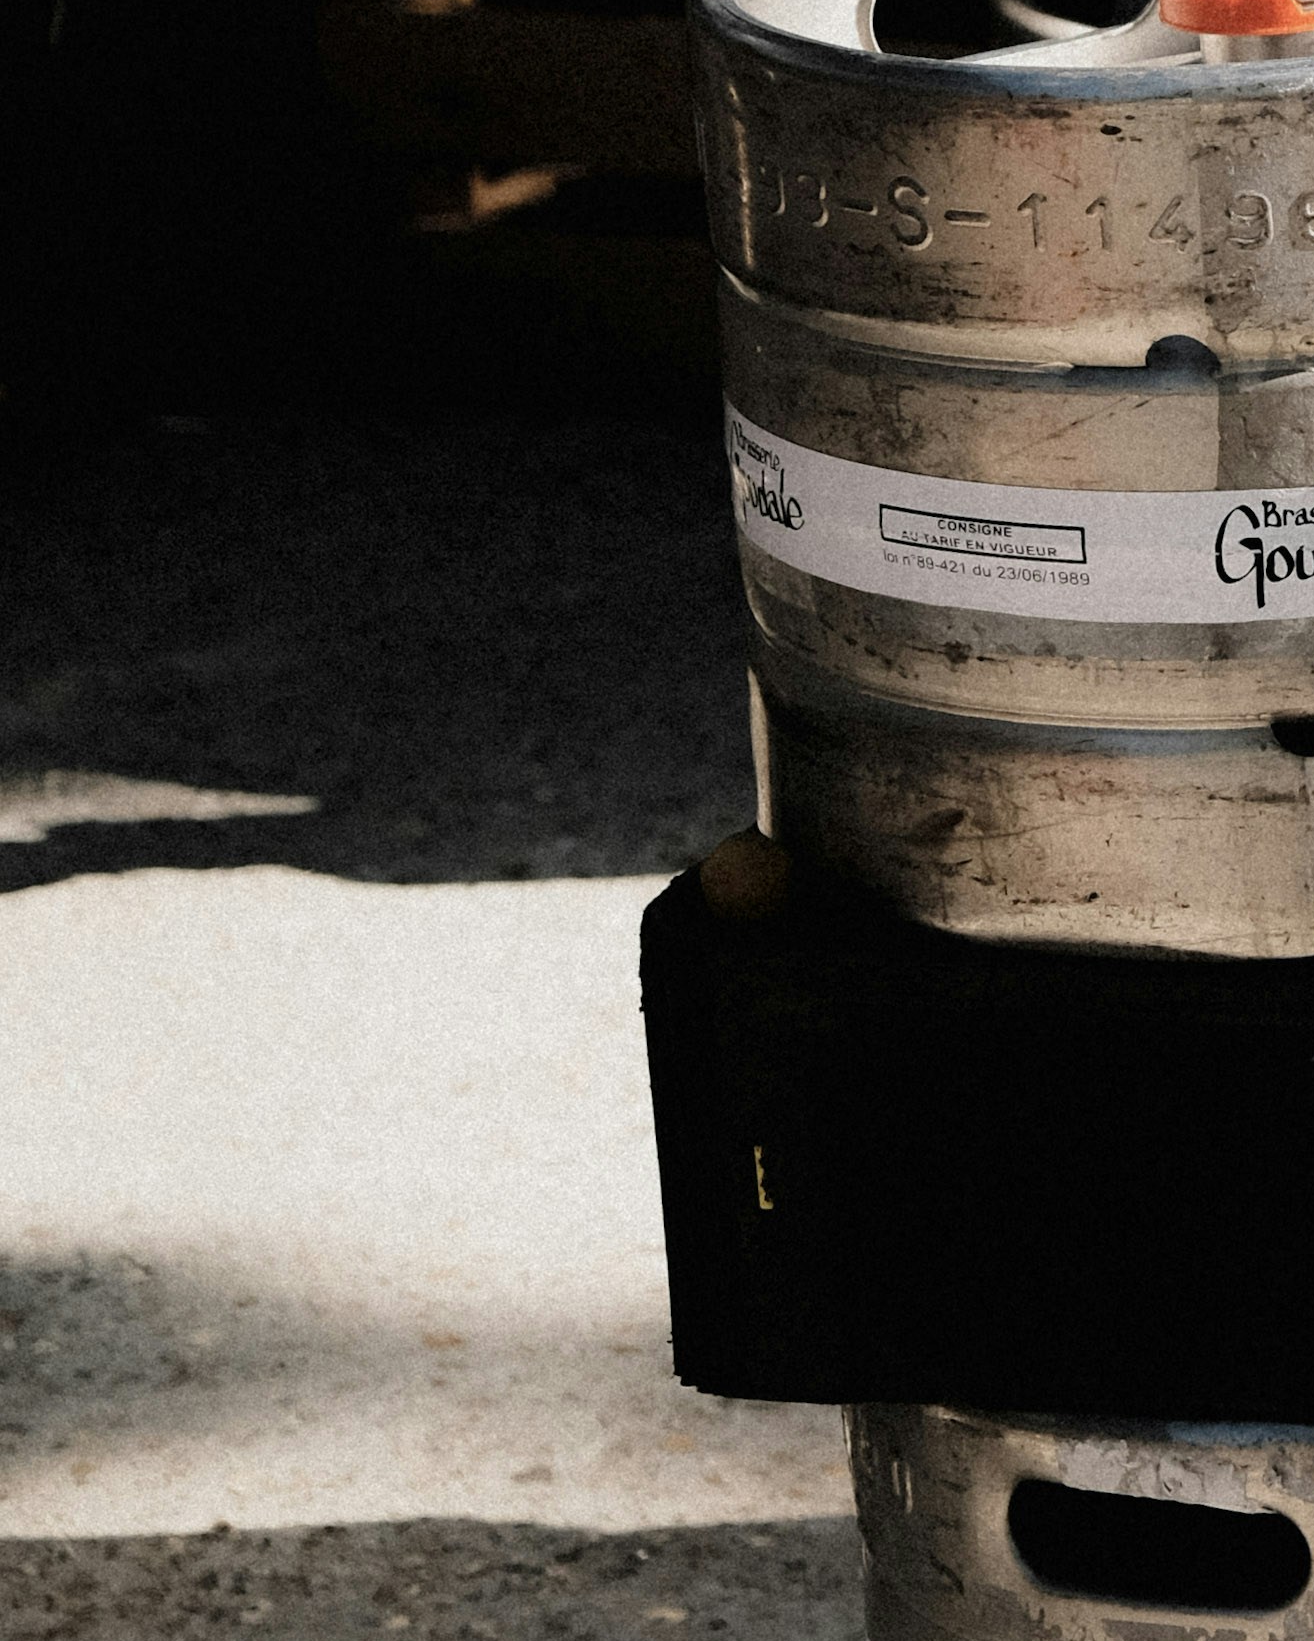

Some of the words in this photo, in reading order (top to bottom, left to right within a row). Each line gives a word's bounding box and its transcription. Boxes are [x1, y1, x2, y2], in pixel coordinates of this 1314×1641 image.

[937, 519, 1013, 538] CONSIGNE
[923, 534, 961, 548] TARIF
[966, 540, 984, 551] EN
[990, 543, 1058, 557] VIGUEUR
[972, 565, 991, 578] du
[997, 566, 1090, 586] 23/06/1989
